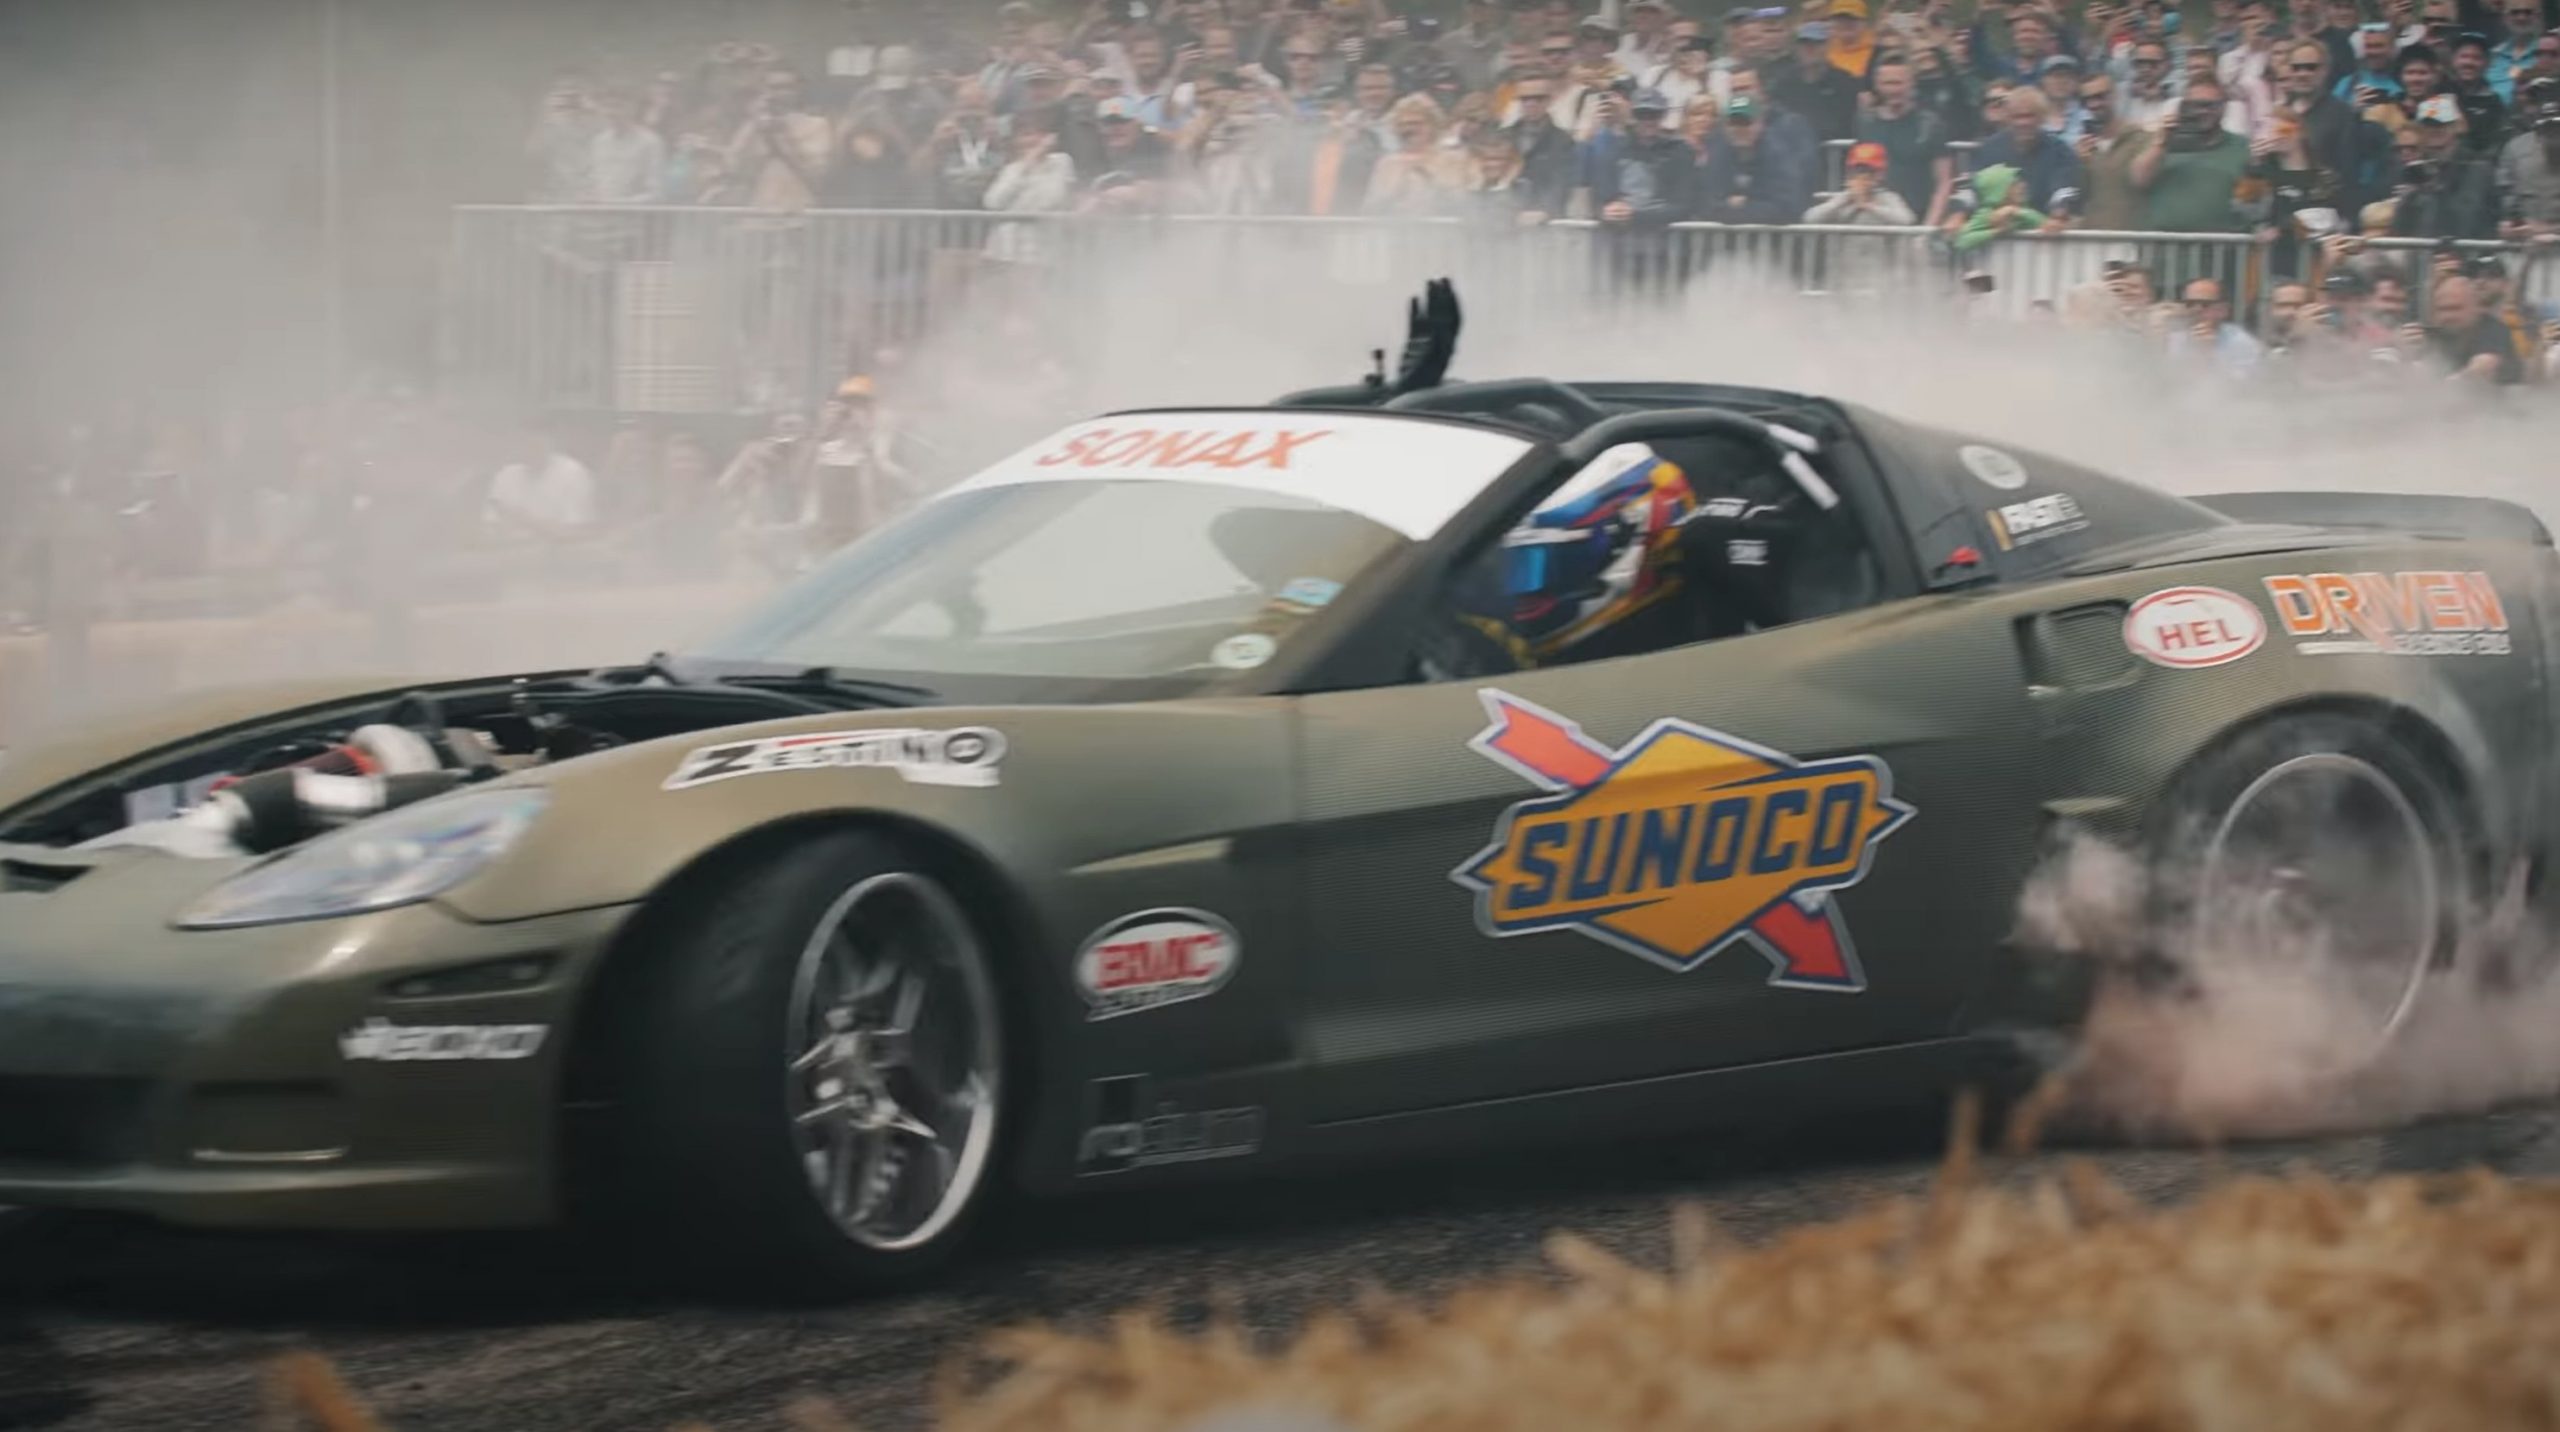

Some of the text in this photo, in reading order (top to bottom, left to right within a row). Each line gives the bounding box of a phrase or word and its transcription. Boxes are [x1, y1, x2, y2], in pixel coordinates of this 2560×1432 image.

[1033, 427, 1335, 470] SONAX
[2262, 572, 2509, 635] DRIVEN
[2156, 618, 2243, 651] HEL
[1506, 781, 1865, 910] SUNOCO
